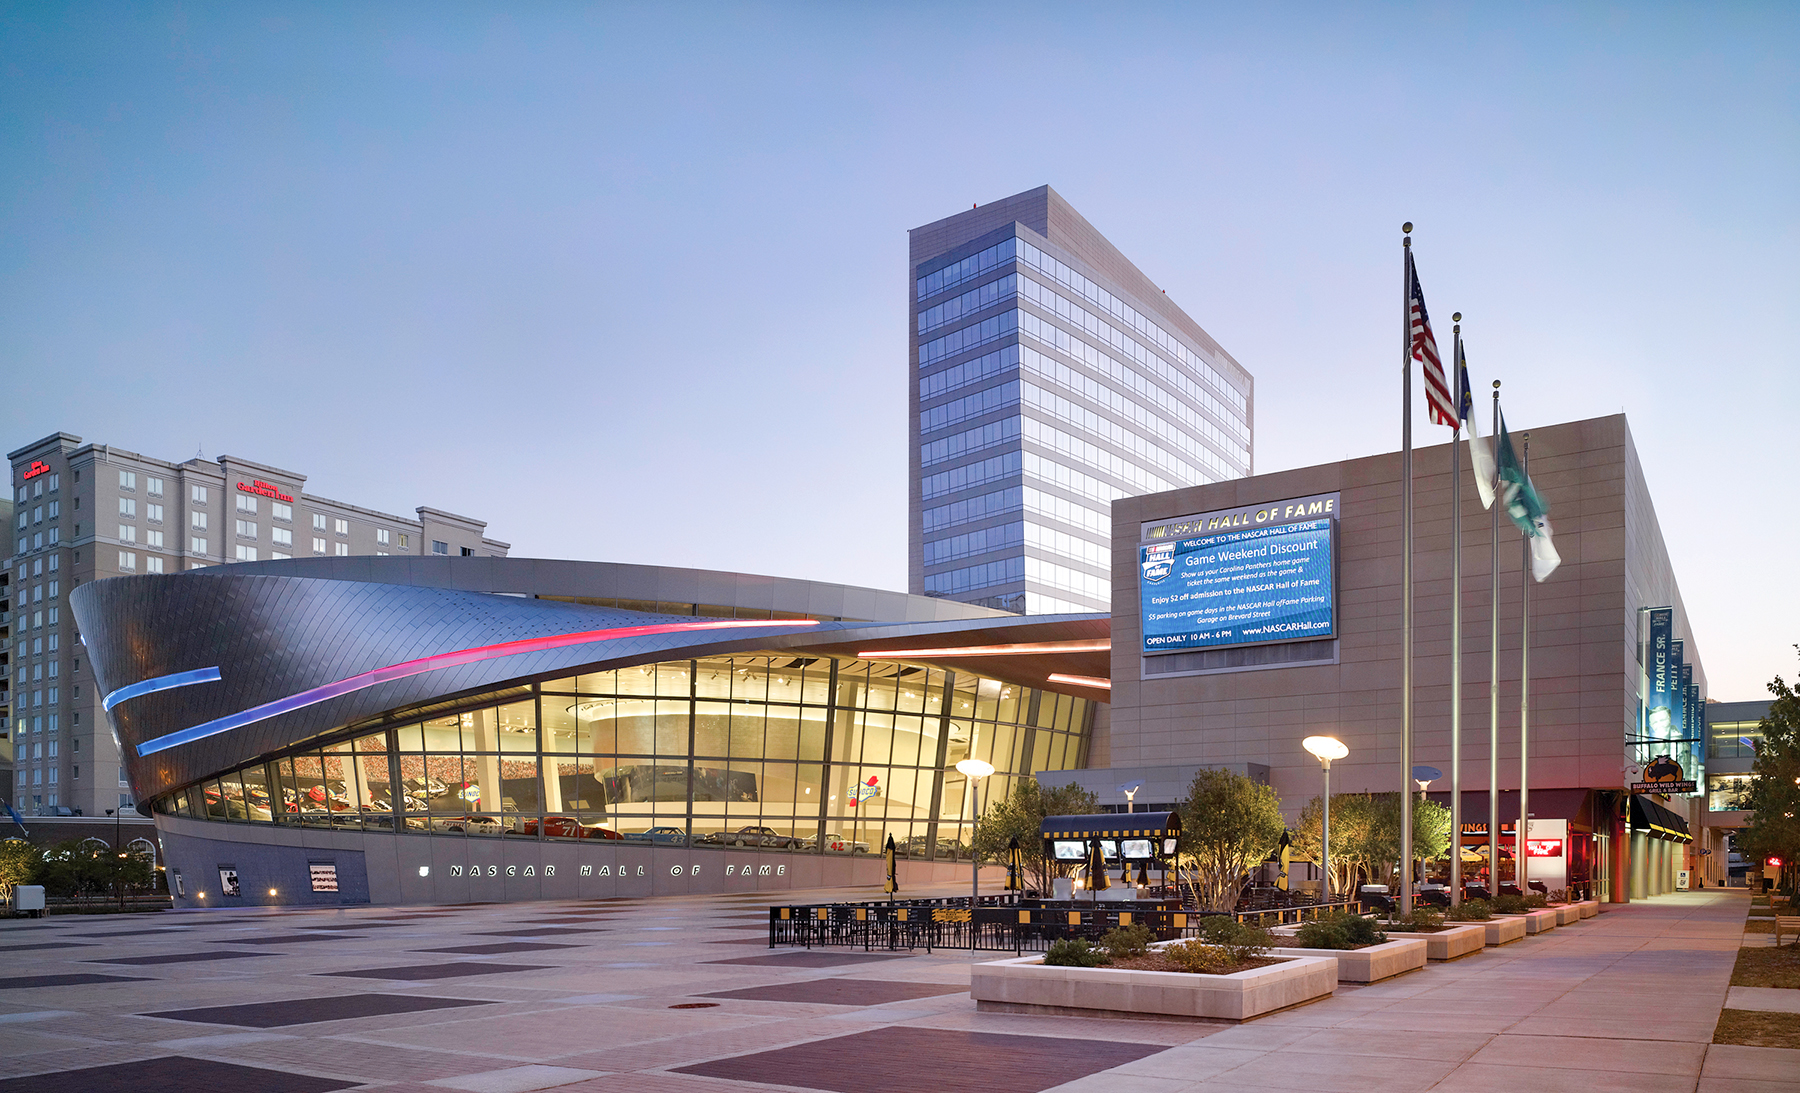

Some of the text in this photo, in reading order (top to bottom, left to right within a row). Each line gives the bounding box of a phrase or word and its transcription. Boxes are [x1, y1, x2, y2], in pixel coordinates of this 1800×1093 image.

[237, 481, 294, 503] Garden Inn
[254, 480, 278, 491] Hilton
[1208, 514, 1249, 530] HALL
[1255, 508, 1279, 523] OF
[1284, 499, 1334, 518] FAME
[1183, 538, 1215, 547] WELCOME
[1216, 535, 1226, 543] TO
[1227, 533, 1240, 541] THE
[1241, 529, 1268, 539] NASCAR
[1269, 527, 1287, 535] HALL
[1299, 522, 1317, 531] FAME
[1149, 552, 1170, 562] HALL
[1185, 539, 1318, 566] Game Weekend Discount
[1146, 567, 1169, 578] FAME
[1205, 569, 1218, 577] your
[1219, 565, 1244, 573] Carolina
[1245, 561, 1271, 570] Panthers
[1273, 559, 1291, 567] home
[1292, 557, 1310, 565] game
[1231, 572, 1258, 581] weekend
[1267, 569, 1278, 577] the
[1278, 568, 1296, 576] game
[1151, 597, 1169, 605] Enjoy
[1170, 594, 1178, 603] $2
[1179, 593, 1190, 601] off
[1190, 590, 1224, 599] admission
[1233, 586, 1244, 594] the
[1246, 583, 1274, 593] NASCAR
[1275, 581, 1290, 589] Hall
[1300, 578, 1320, 587] Fame
[1156, 611, 1178, 620] parking
[1187, 609, 1204, 617] game
[1237, 602, 1262, 611] NASCAR
[1300, 596, 1325, 604] Parking
[1228, 612, 1252, 620] Brevard
[1242, 621, 1330, 635] www.NASCARHall.com
[1146, 636, 1165, 645] OPEN
[1166, 635, 1187, 643] DAILY
[1199, 632, 1210, 640] AM
[1221, 630, 1232, 638] PM
[1656, 634, 1666, 649] SR.
[1656, 652, 1665, 693] FRANCE
[562, 826, 577, 837] 71
[670, 835, 685, 844] 43
[761, 835, 778, 847] 22
[830, 841, 844, 851] 42
[450, 864, 786, 877] NASCAR HALL OF FAME
